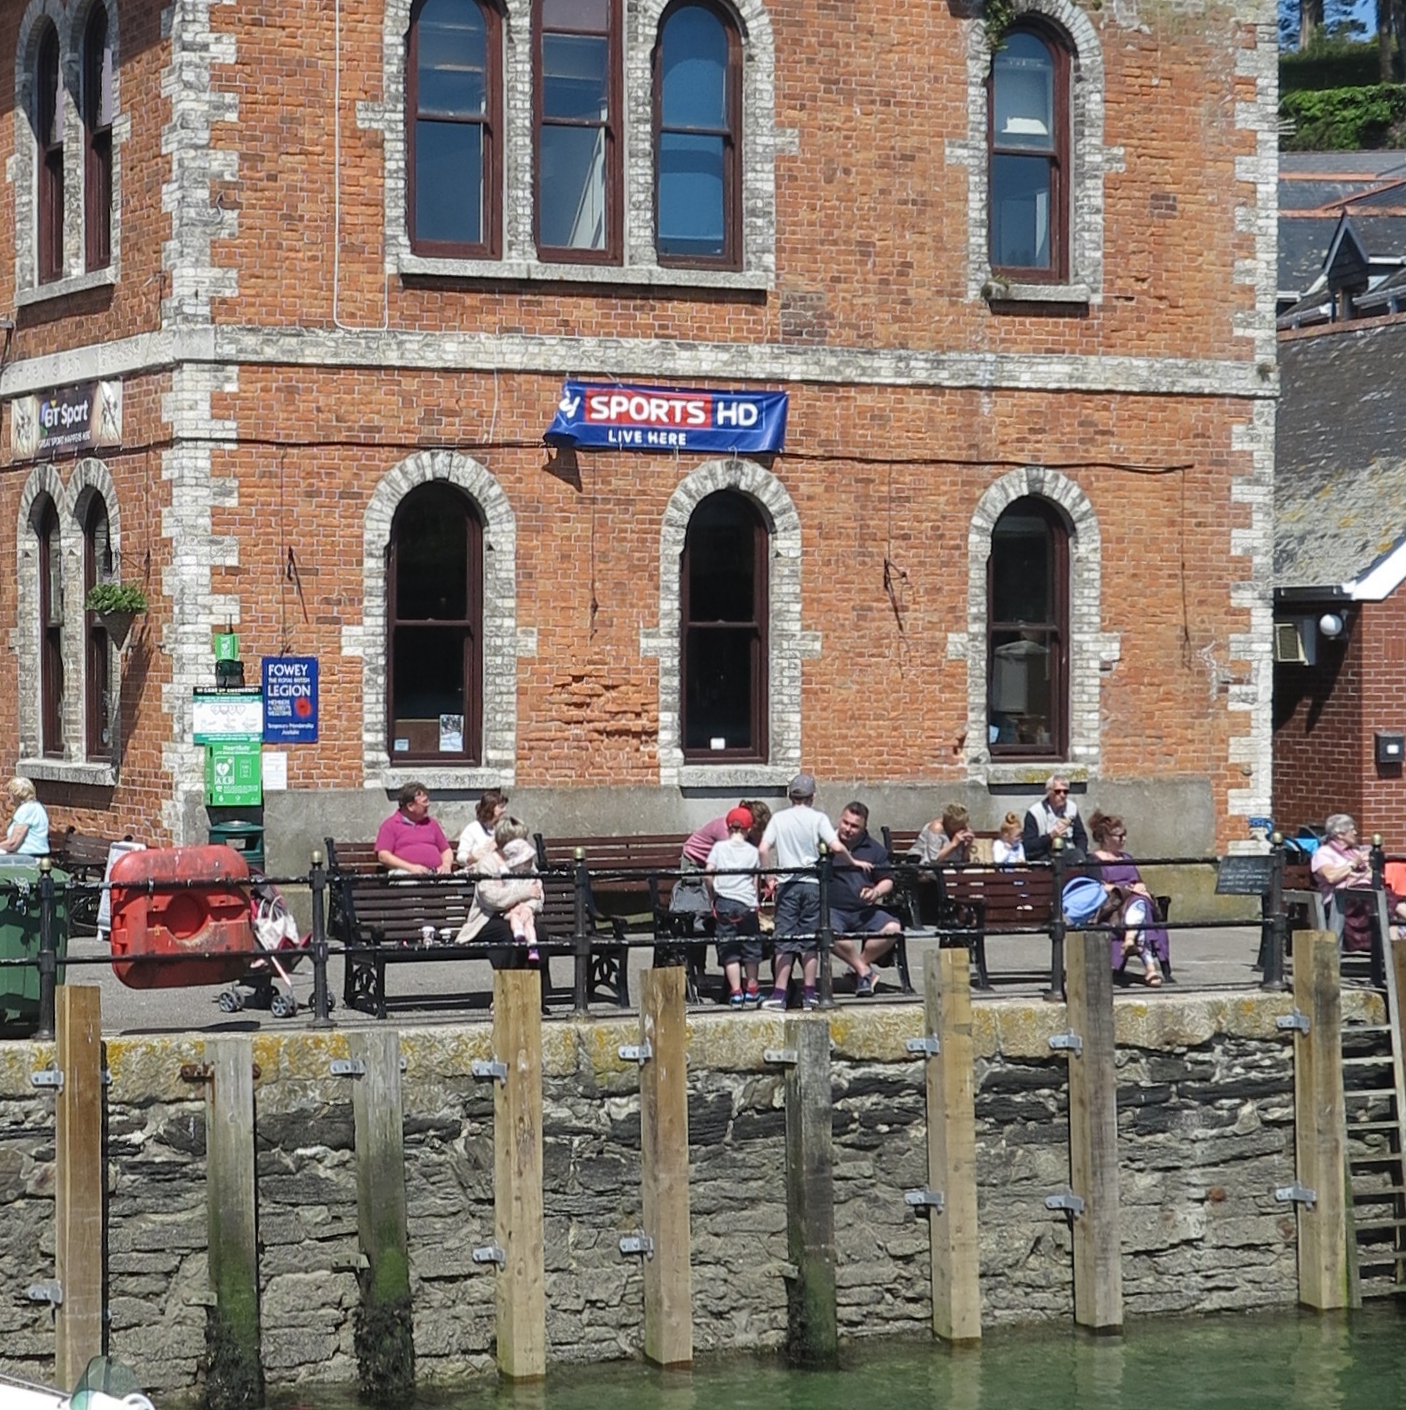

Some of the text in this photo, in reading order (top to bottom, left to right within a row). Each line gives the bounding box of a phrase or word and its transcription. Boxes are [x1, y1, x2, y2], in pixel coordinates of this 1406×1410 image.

[44, 400, 88, 428] BT Sport
[590, 395, 706, 424] SPORTS
[716, 401, 758, 426] HD
[608, 429, 686, 446] LIVE HERE
[268, 664, 308, 676] FOWEY
[267, 684, 311, 696] LEGION
